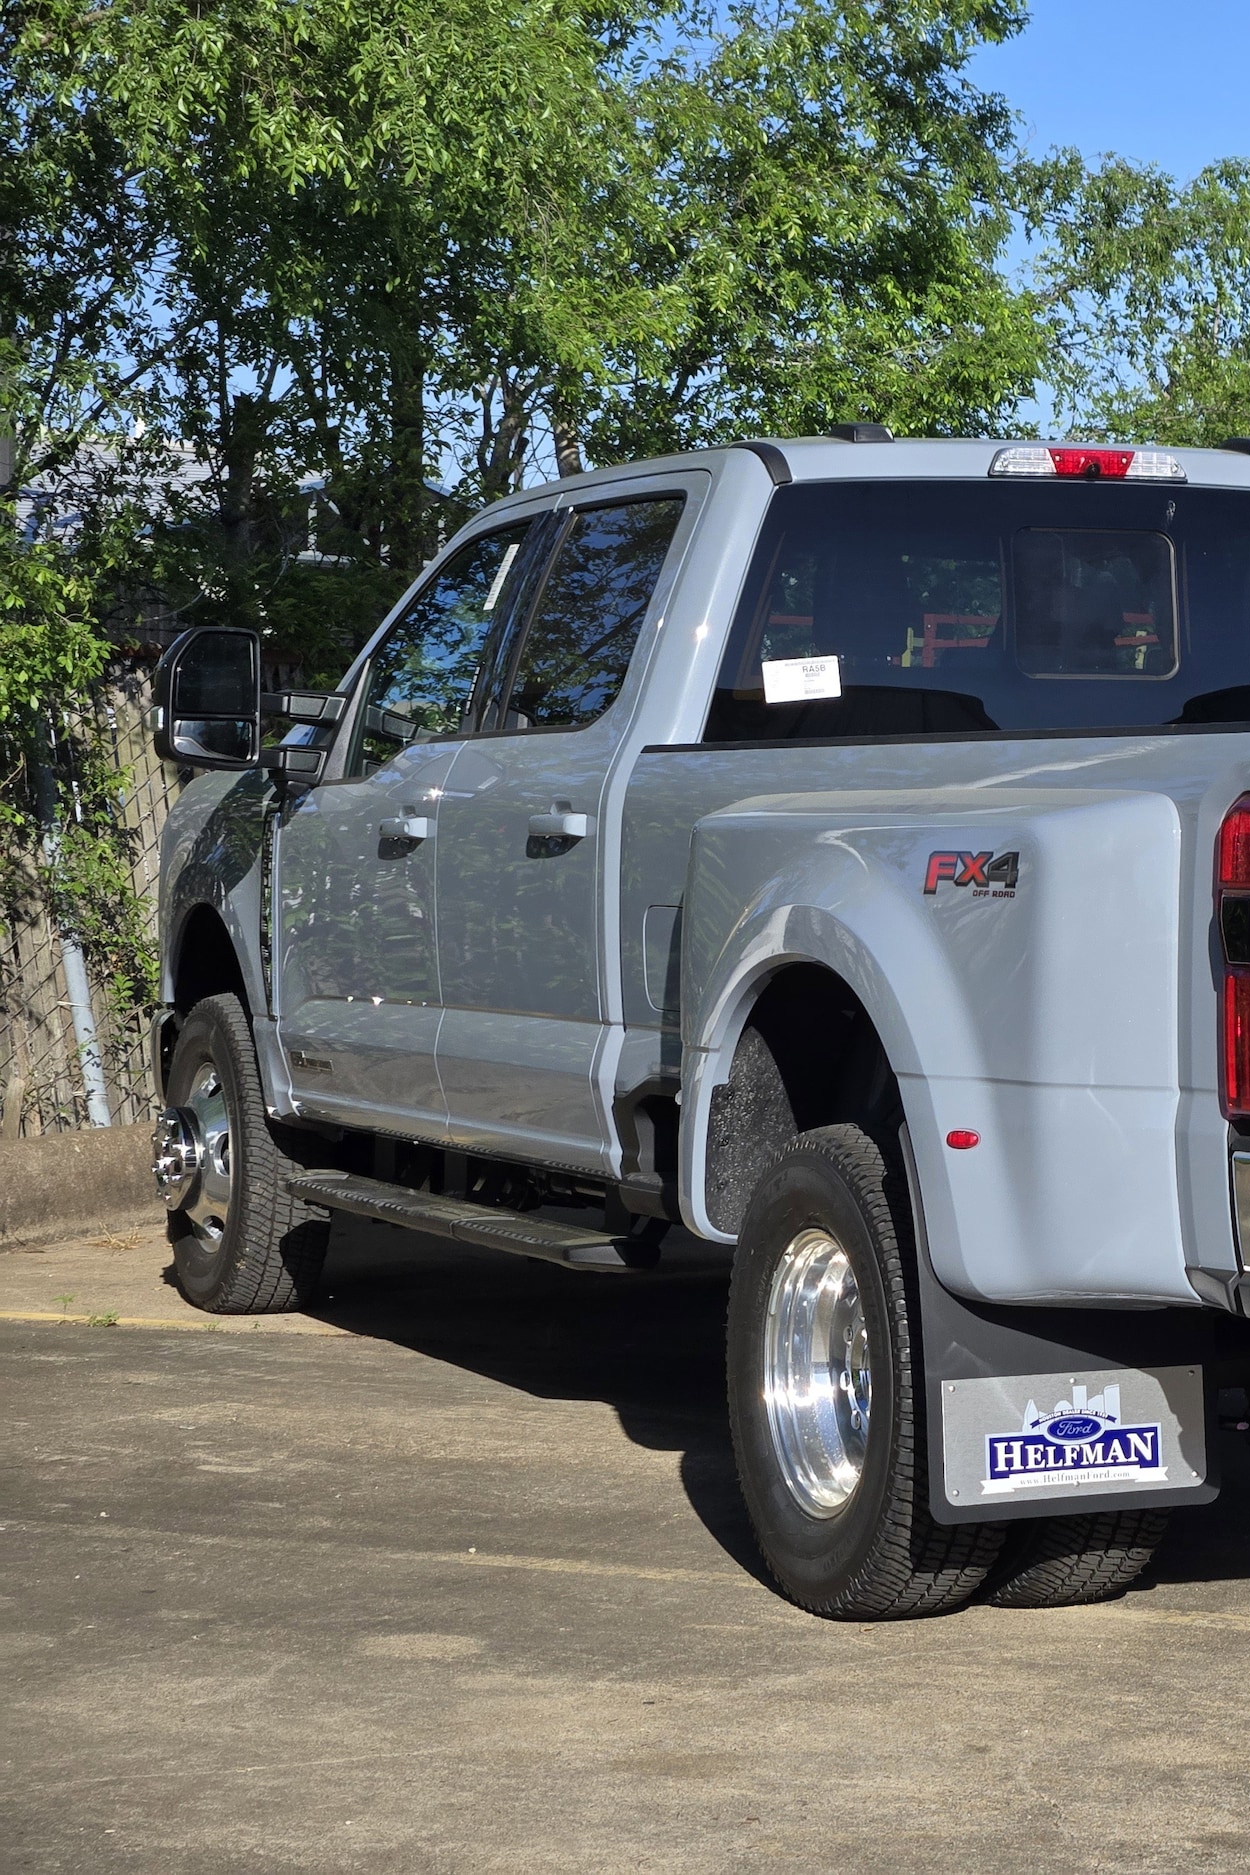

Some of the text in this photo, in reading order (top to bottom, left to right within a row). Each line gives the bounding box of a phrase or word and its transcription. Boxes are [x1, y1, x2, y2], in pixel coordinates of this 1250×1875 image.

[923, 851, 1020, 894] FX4
[972, 889, 1015, 898] OFF ROAD
[1056, 1420, 1093, 1436] Ford
[994, 1432, 1155, 1472] HELFMAN
[1020, 1469, 1130, 1485] www.HelfmanFord.com
